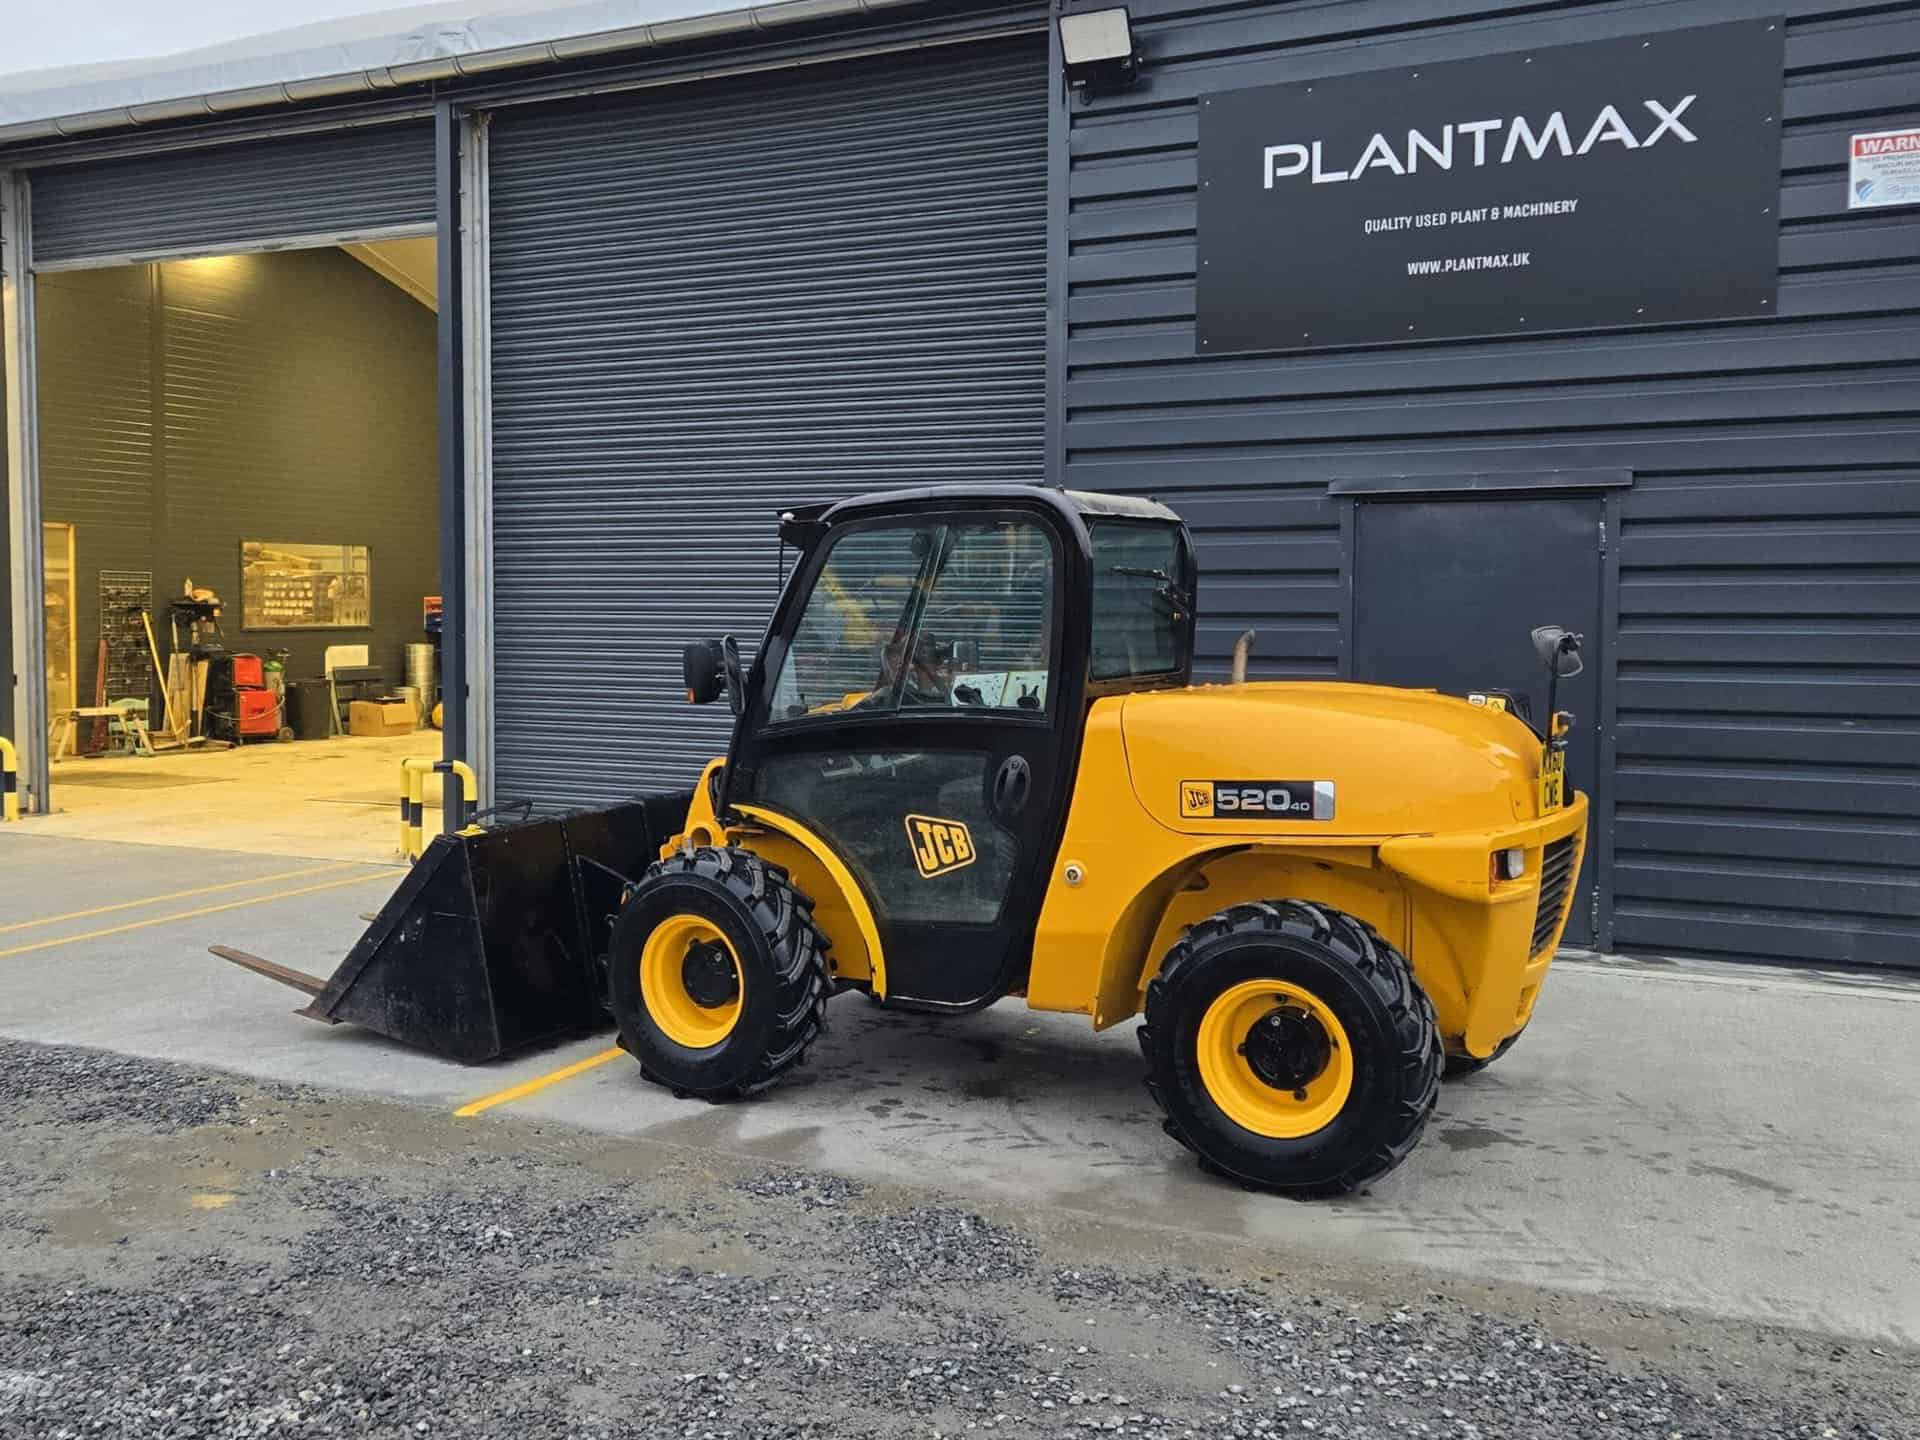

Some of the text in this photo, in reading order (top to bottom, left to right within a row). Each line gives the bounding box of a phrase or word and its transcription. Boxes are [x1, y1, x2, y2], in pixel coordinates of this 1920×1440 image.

[1263, 94, 1698, 189] PLANTMAX
[1364, 199, 1579, 235] QUALITY USED PLANT & MACHINERY
[1407, 252, 1530, 276] WWW.PLANTMAX.UK
[1187, 788, 1210, 810] JCB
[914, 821, 970, 871] JCB
